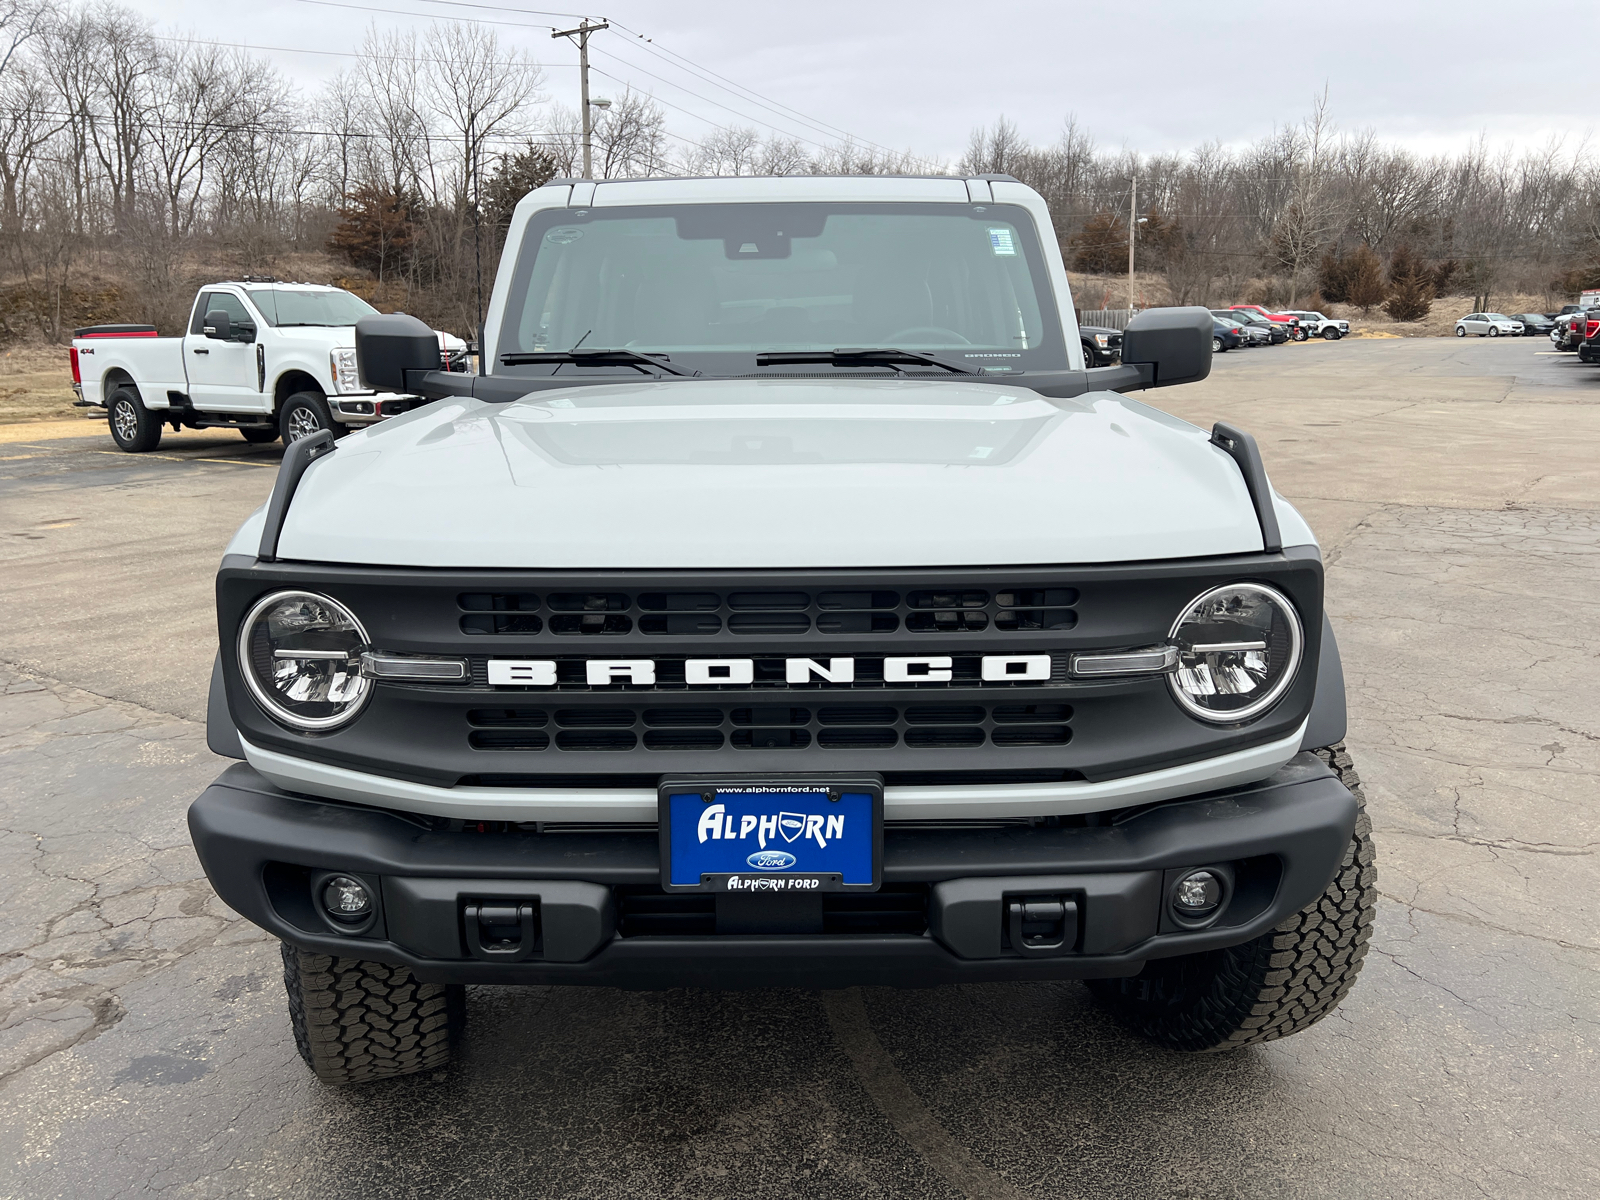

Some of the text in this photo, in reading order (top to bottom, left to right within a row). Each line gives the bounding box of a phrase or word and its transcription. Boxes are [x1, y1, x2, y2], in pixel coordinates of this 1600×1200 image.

[487, 654, 1051, 685] BRONCO
[716, 786, 830, 794] www.alphornford.net
[697, 804, 845, 849] ALPHORN
[757, 854, 786, 867] Ford
[727, 876, 819, 892] ALPHORN FORD
